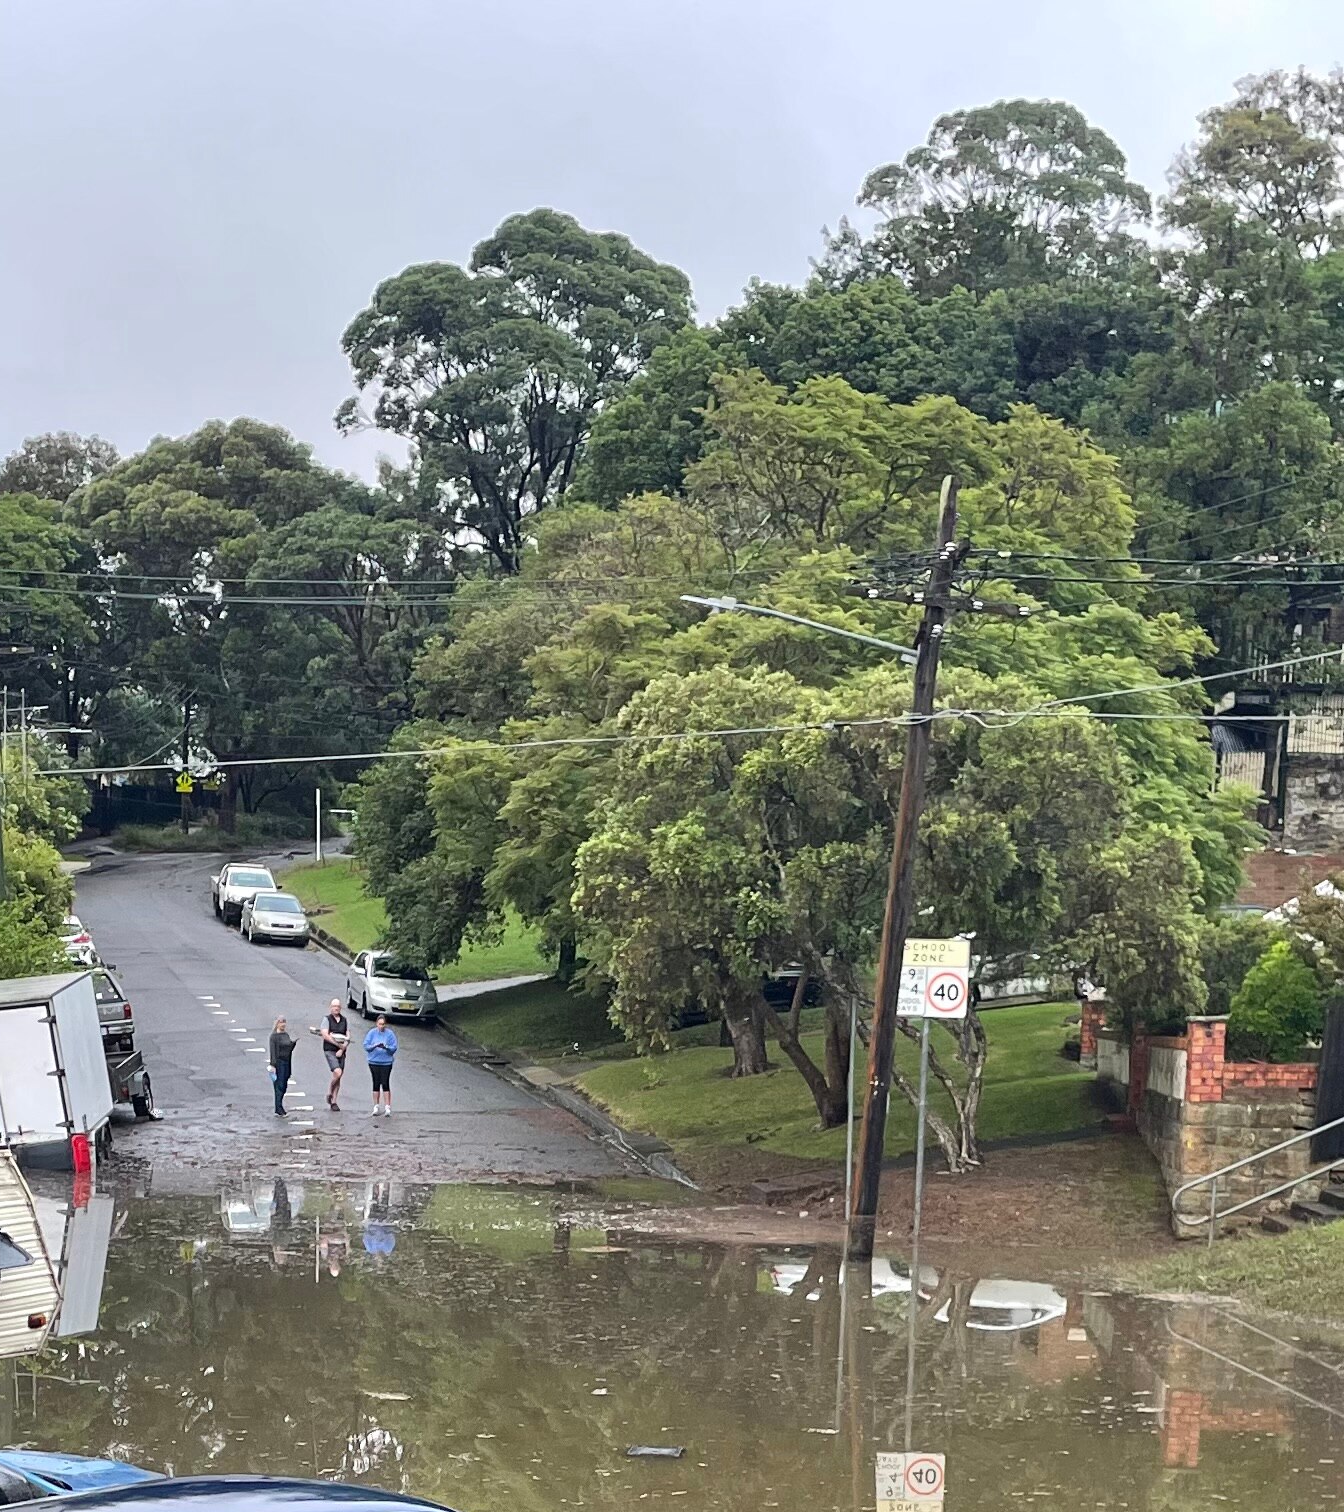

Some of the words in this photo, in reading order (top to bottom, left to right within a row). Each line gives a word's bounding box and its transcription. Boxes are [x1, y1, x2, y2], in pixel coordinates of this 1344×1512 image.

[904, 943, 954, 952] SCHOOL
[912, 954, 945, 962] ZONE
[933, 983, 959, 1001] 40
